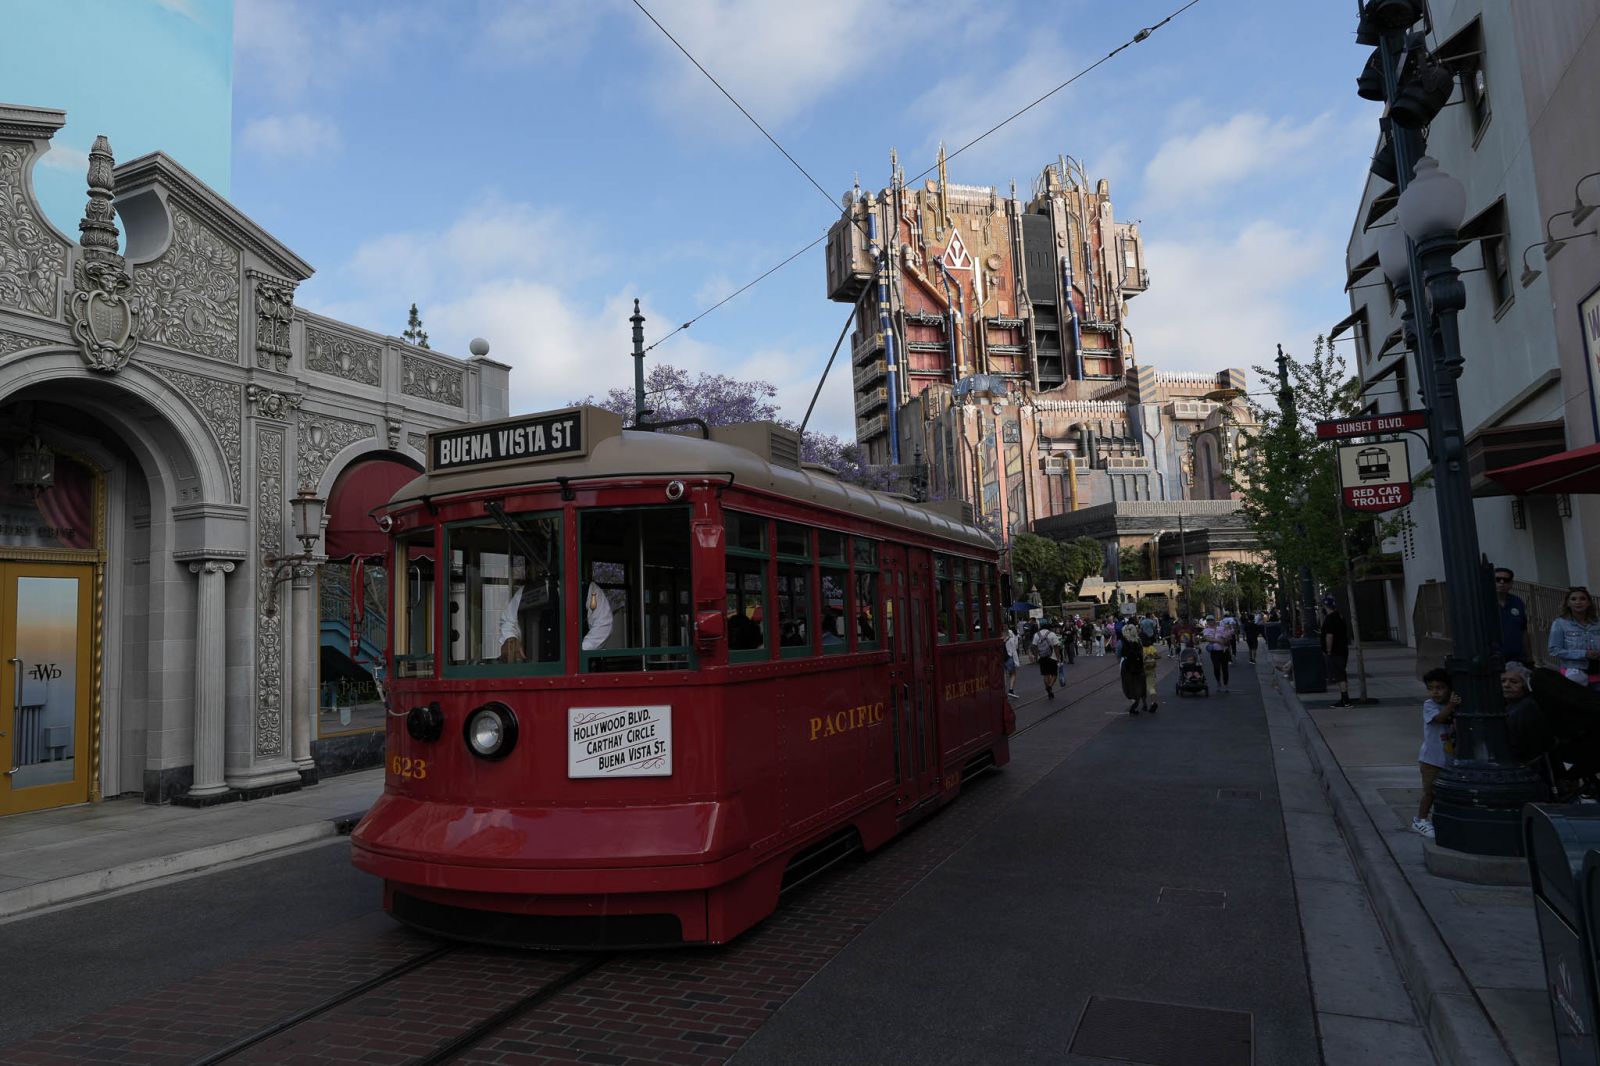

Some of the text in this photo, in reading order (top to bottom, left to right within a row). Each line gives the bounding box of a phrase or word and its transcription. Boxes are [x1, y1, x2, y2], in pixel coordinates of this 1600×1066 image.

[1336, 417, 1405, 434] SUNSET BLVD.
[440, 420, 574, 465] BUENA VISTA ST
[1352, 494, 1403, 507] TROLLEY
[1353, 486, 1401, 498] RED CAR
[573, 709, 651, 742] HOLLYWOOD BLVD.
[809, 702, 885, 741] PACIFIC
[586, 725, 655, 755] CARTHAY CIRCLE
[598, 740, 666, 770] BUENA VISTA ST.
[392, 755, 427, 779] 623
